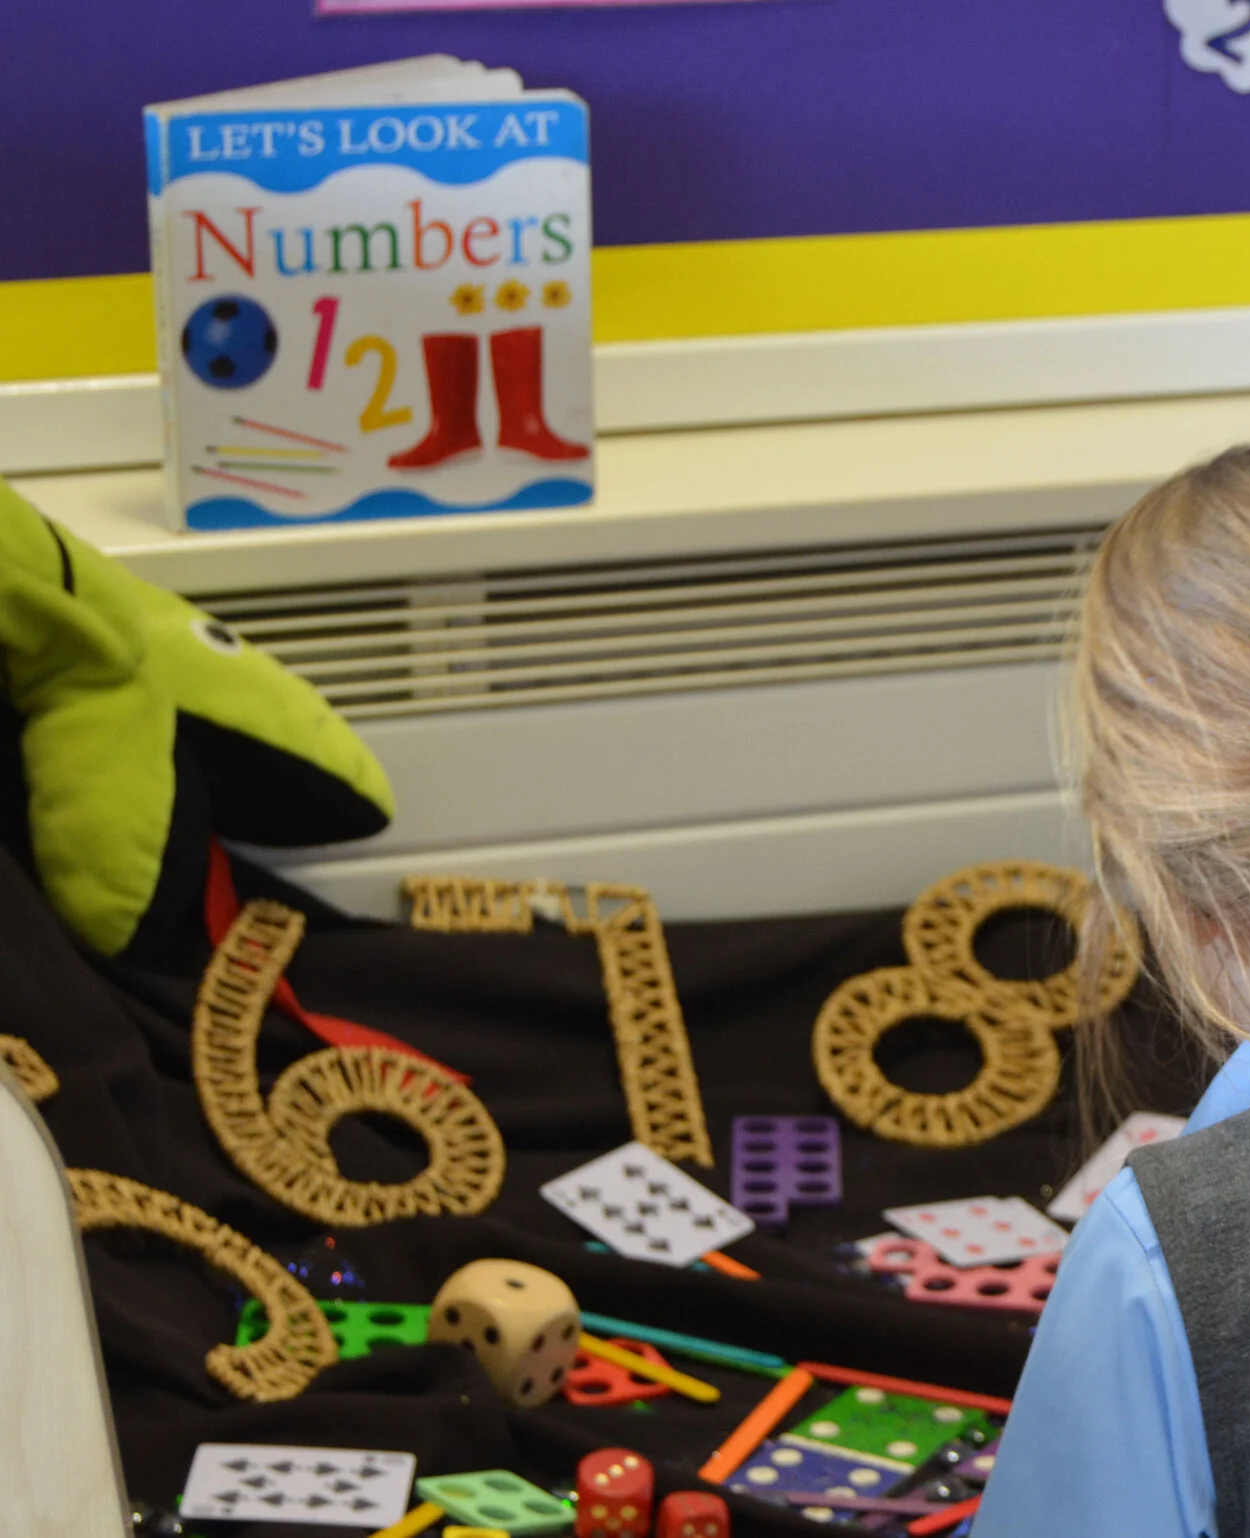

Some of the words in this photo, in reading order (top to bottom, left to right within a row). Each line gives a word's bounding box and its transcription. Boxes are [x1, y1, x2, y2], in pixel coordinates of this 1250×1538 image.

[187, 121, 325, 162] LET'S
[338, 114, 484, 155] LOOK
[493, 110, 560, 148] AT
[181, 198, 575, 284] Numbers
[306, 294, 340, 392] 1
[343, 334, 414, 435] 2
[403, 877, 713, 1169] 7
[814, 862, 1140, 1145] 8
[195, 901, 506, 1227] 6
